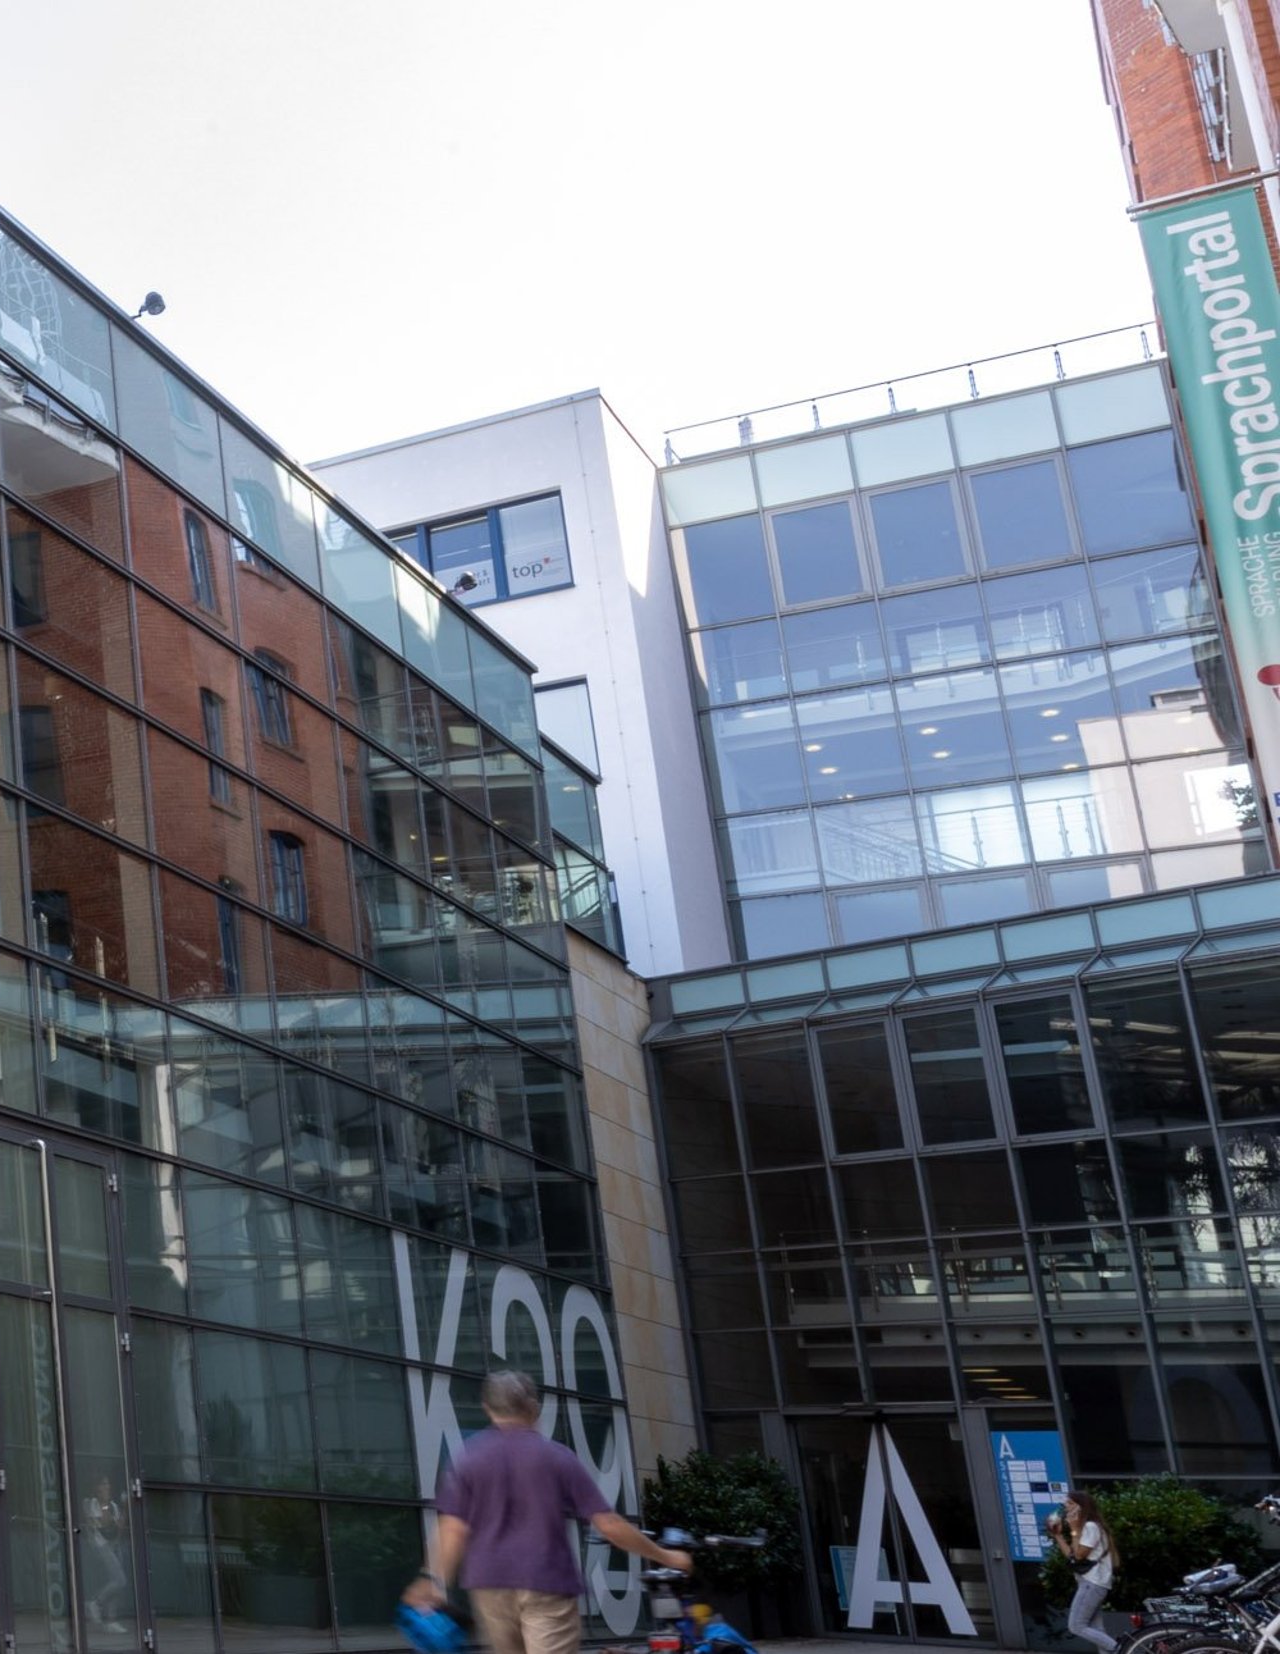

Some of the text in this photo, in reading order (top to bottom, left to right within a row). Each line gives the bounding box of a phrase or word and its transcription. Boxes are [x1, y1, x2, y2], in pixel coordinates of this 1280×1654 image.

[1166, 210, 1280, 523] Sprachportal
[512, 563, 543, 579] top
[1239, 534, 1275, 619] SPRACHE
[1000, 1433, 1015, 1459] A
[846, 1422, 979, 1637] A
